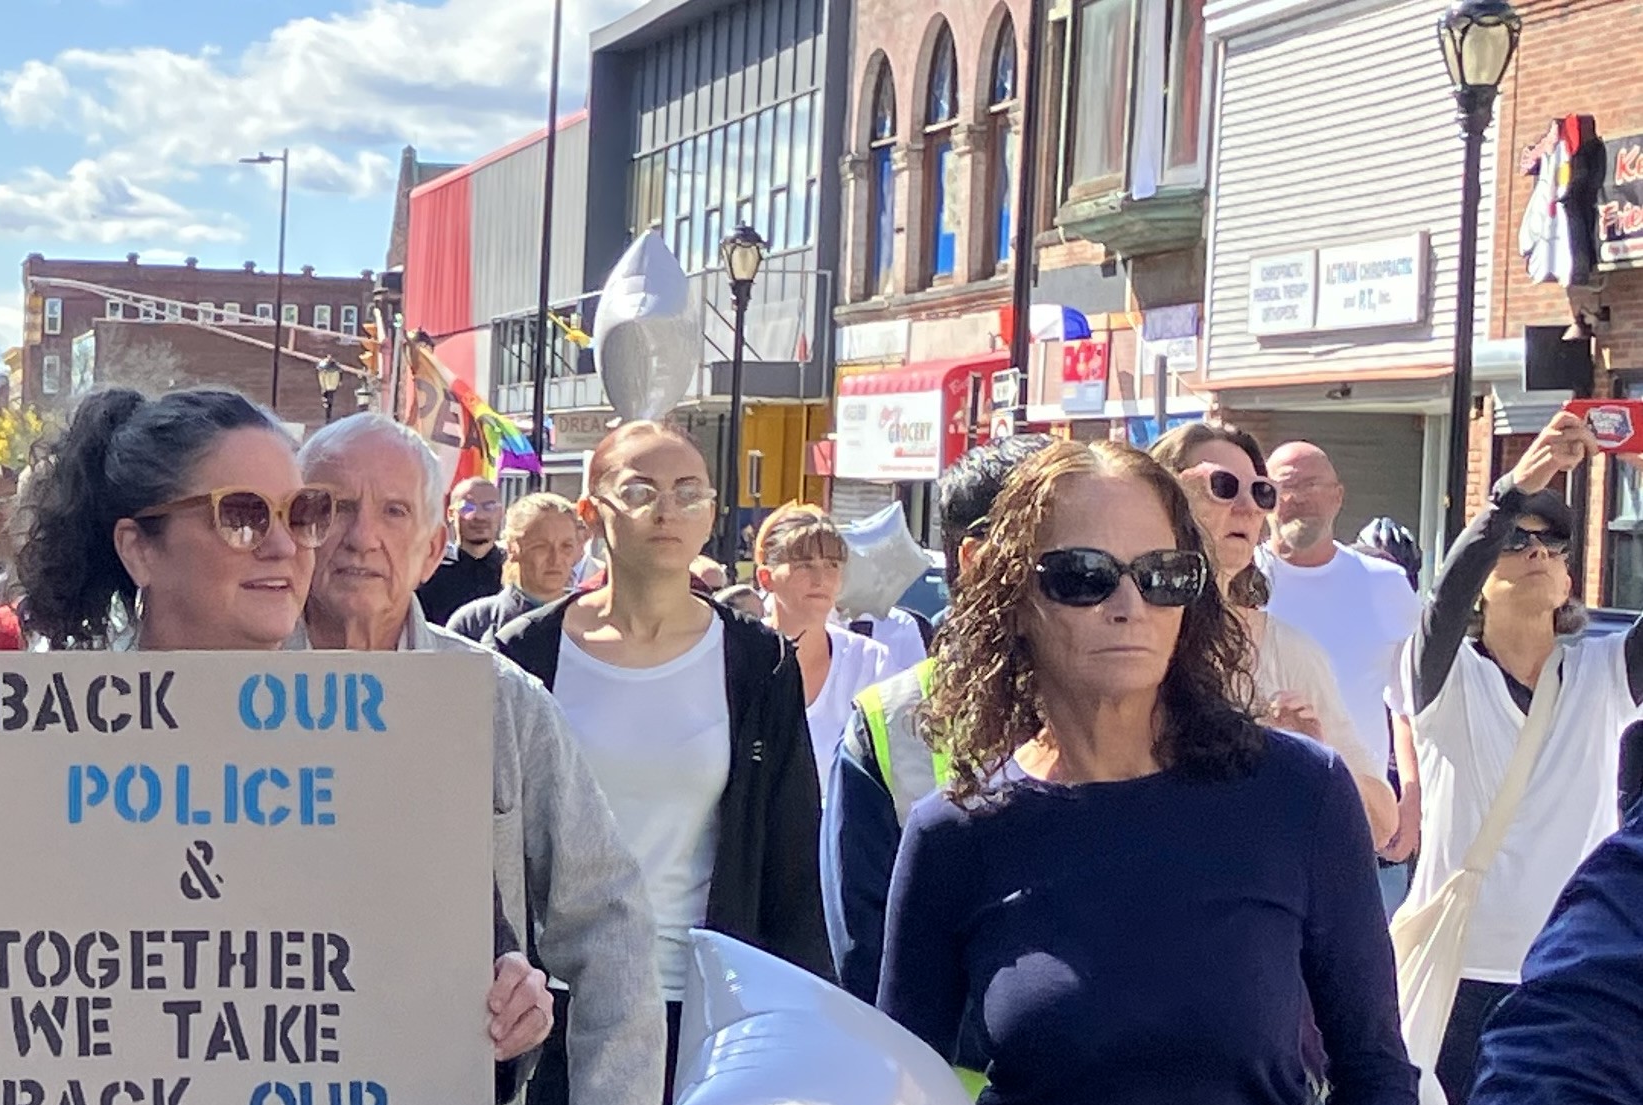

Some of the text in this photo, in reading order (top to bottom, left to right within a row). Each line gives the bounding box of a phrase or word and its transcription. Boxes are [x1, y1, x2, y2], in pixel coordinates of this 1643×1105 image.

[239, 672, 388, 732] OUR
[68, 763, 336, 826] POLICE
[180, 840, 224, 900] &
[12, 996, 341, 1063] WE TAKE
